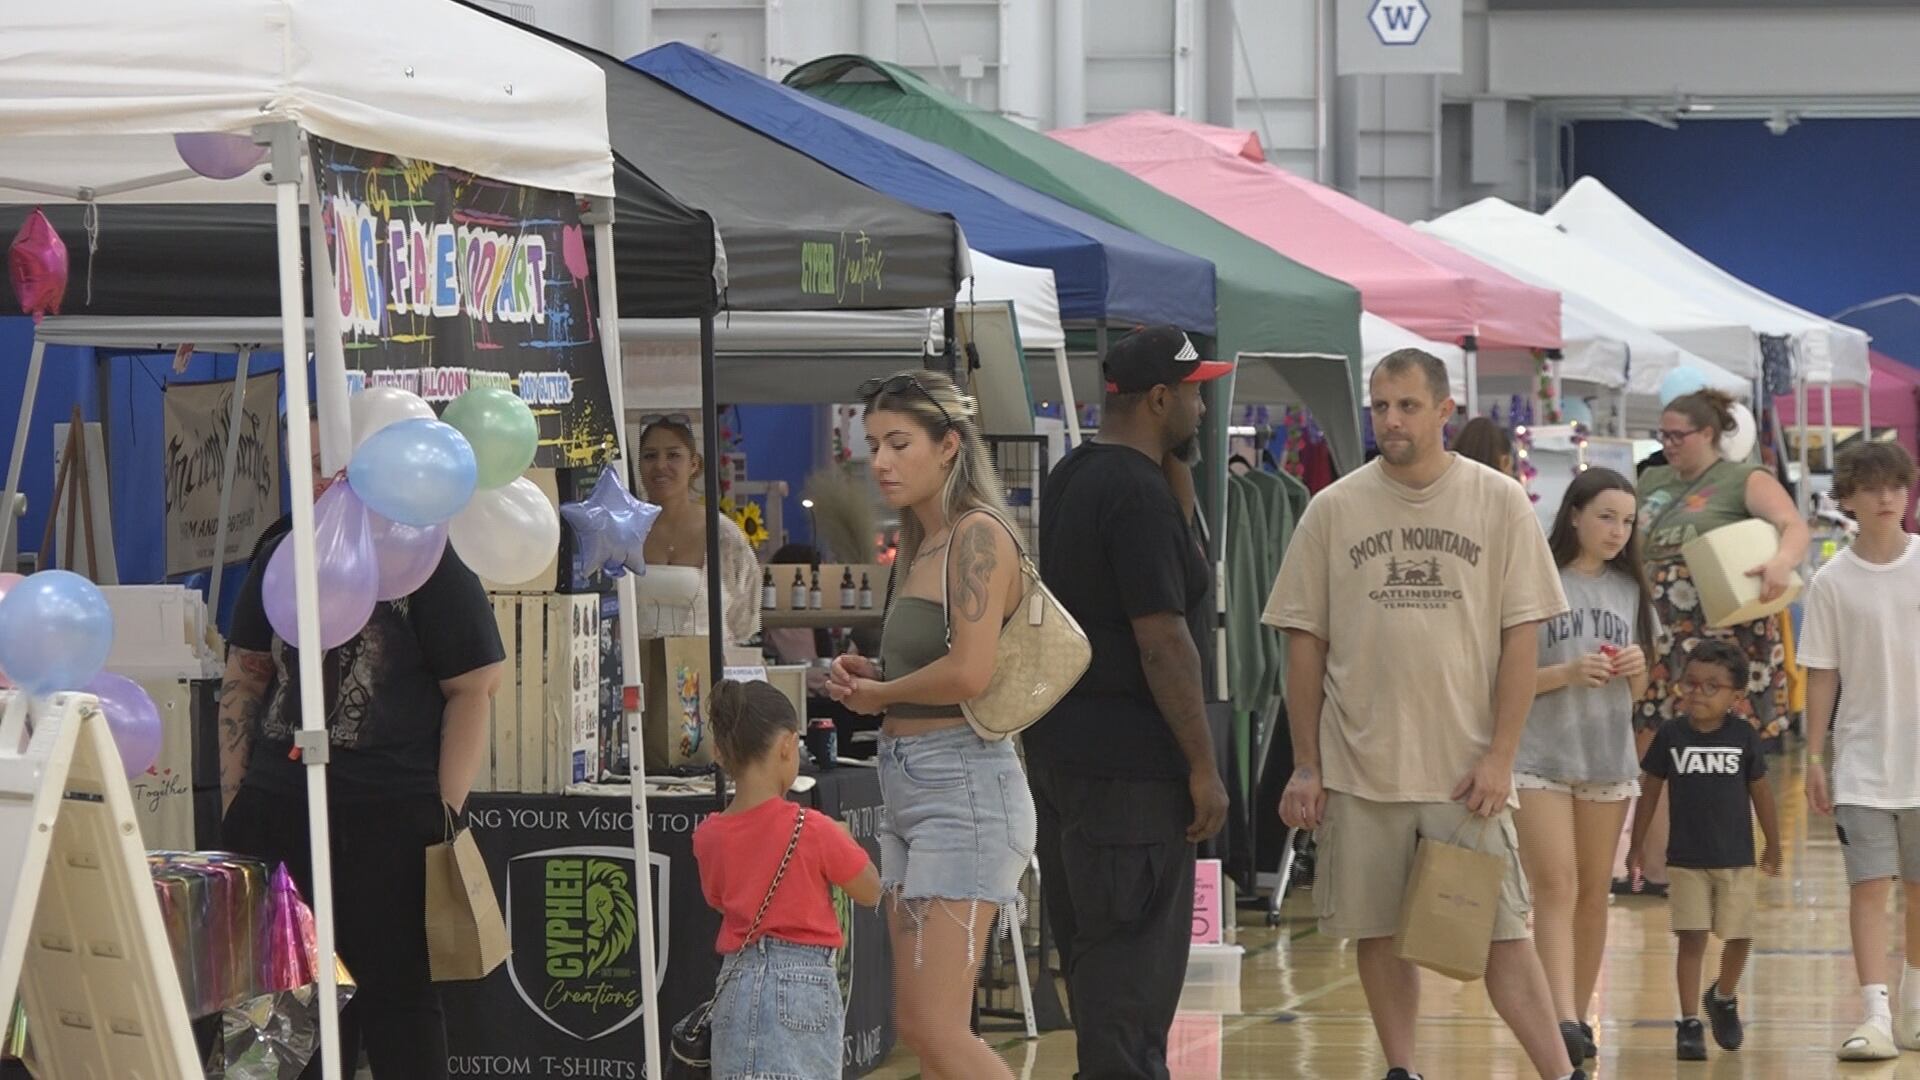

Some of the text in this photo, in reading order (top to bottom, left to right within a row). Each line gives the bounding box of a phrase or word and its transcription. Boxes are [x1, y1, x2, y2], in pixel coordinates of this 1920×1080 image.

[1382, 6, 1416, 30] W
[389, 226, 459, 316] FAE
[1349, 527, 1481, 569] SMOKY MOUNTAINS
[1368, 590, 1462, 600] GATLINBURG
[1547, 608, 1583, 648] NEW
[1671, 747, 1743, 774] VANS
[135, 774, 188, 813] Together
[507, 808, 571, 831] YOUR
[658, 813, 689, 832] TO
[546, 859, 584, 978] CYPHER
[544, 979, 639, 1014] Creations
[447, 1056, 531, 1074] CUSTOM
[539, 1056, 635, 1080] T-SHIRTS
